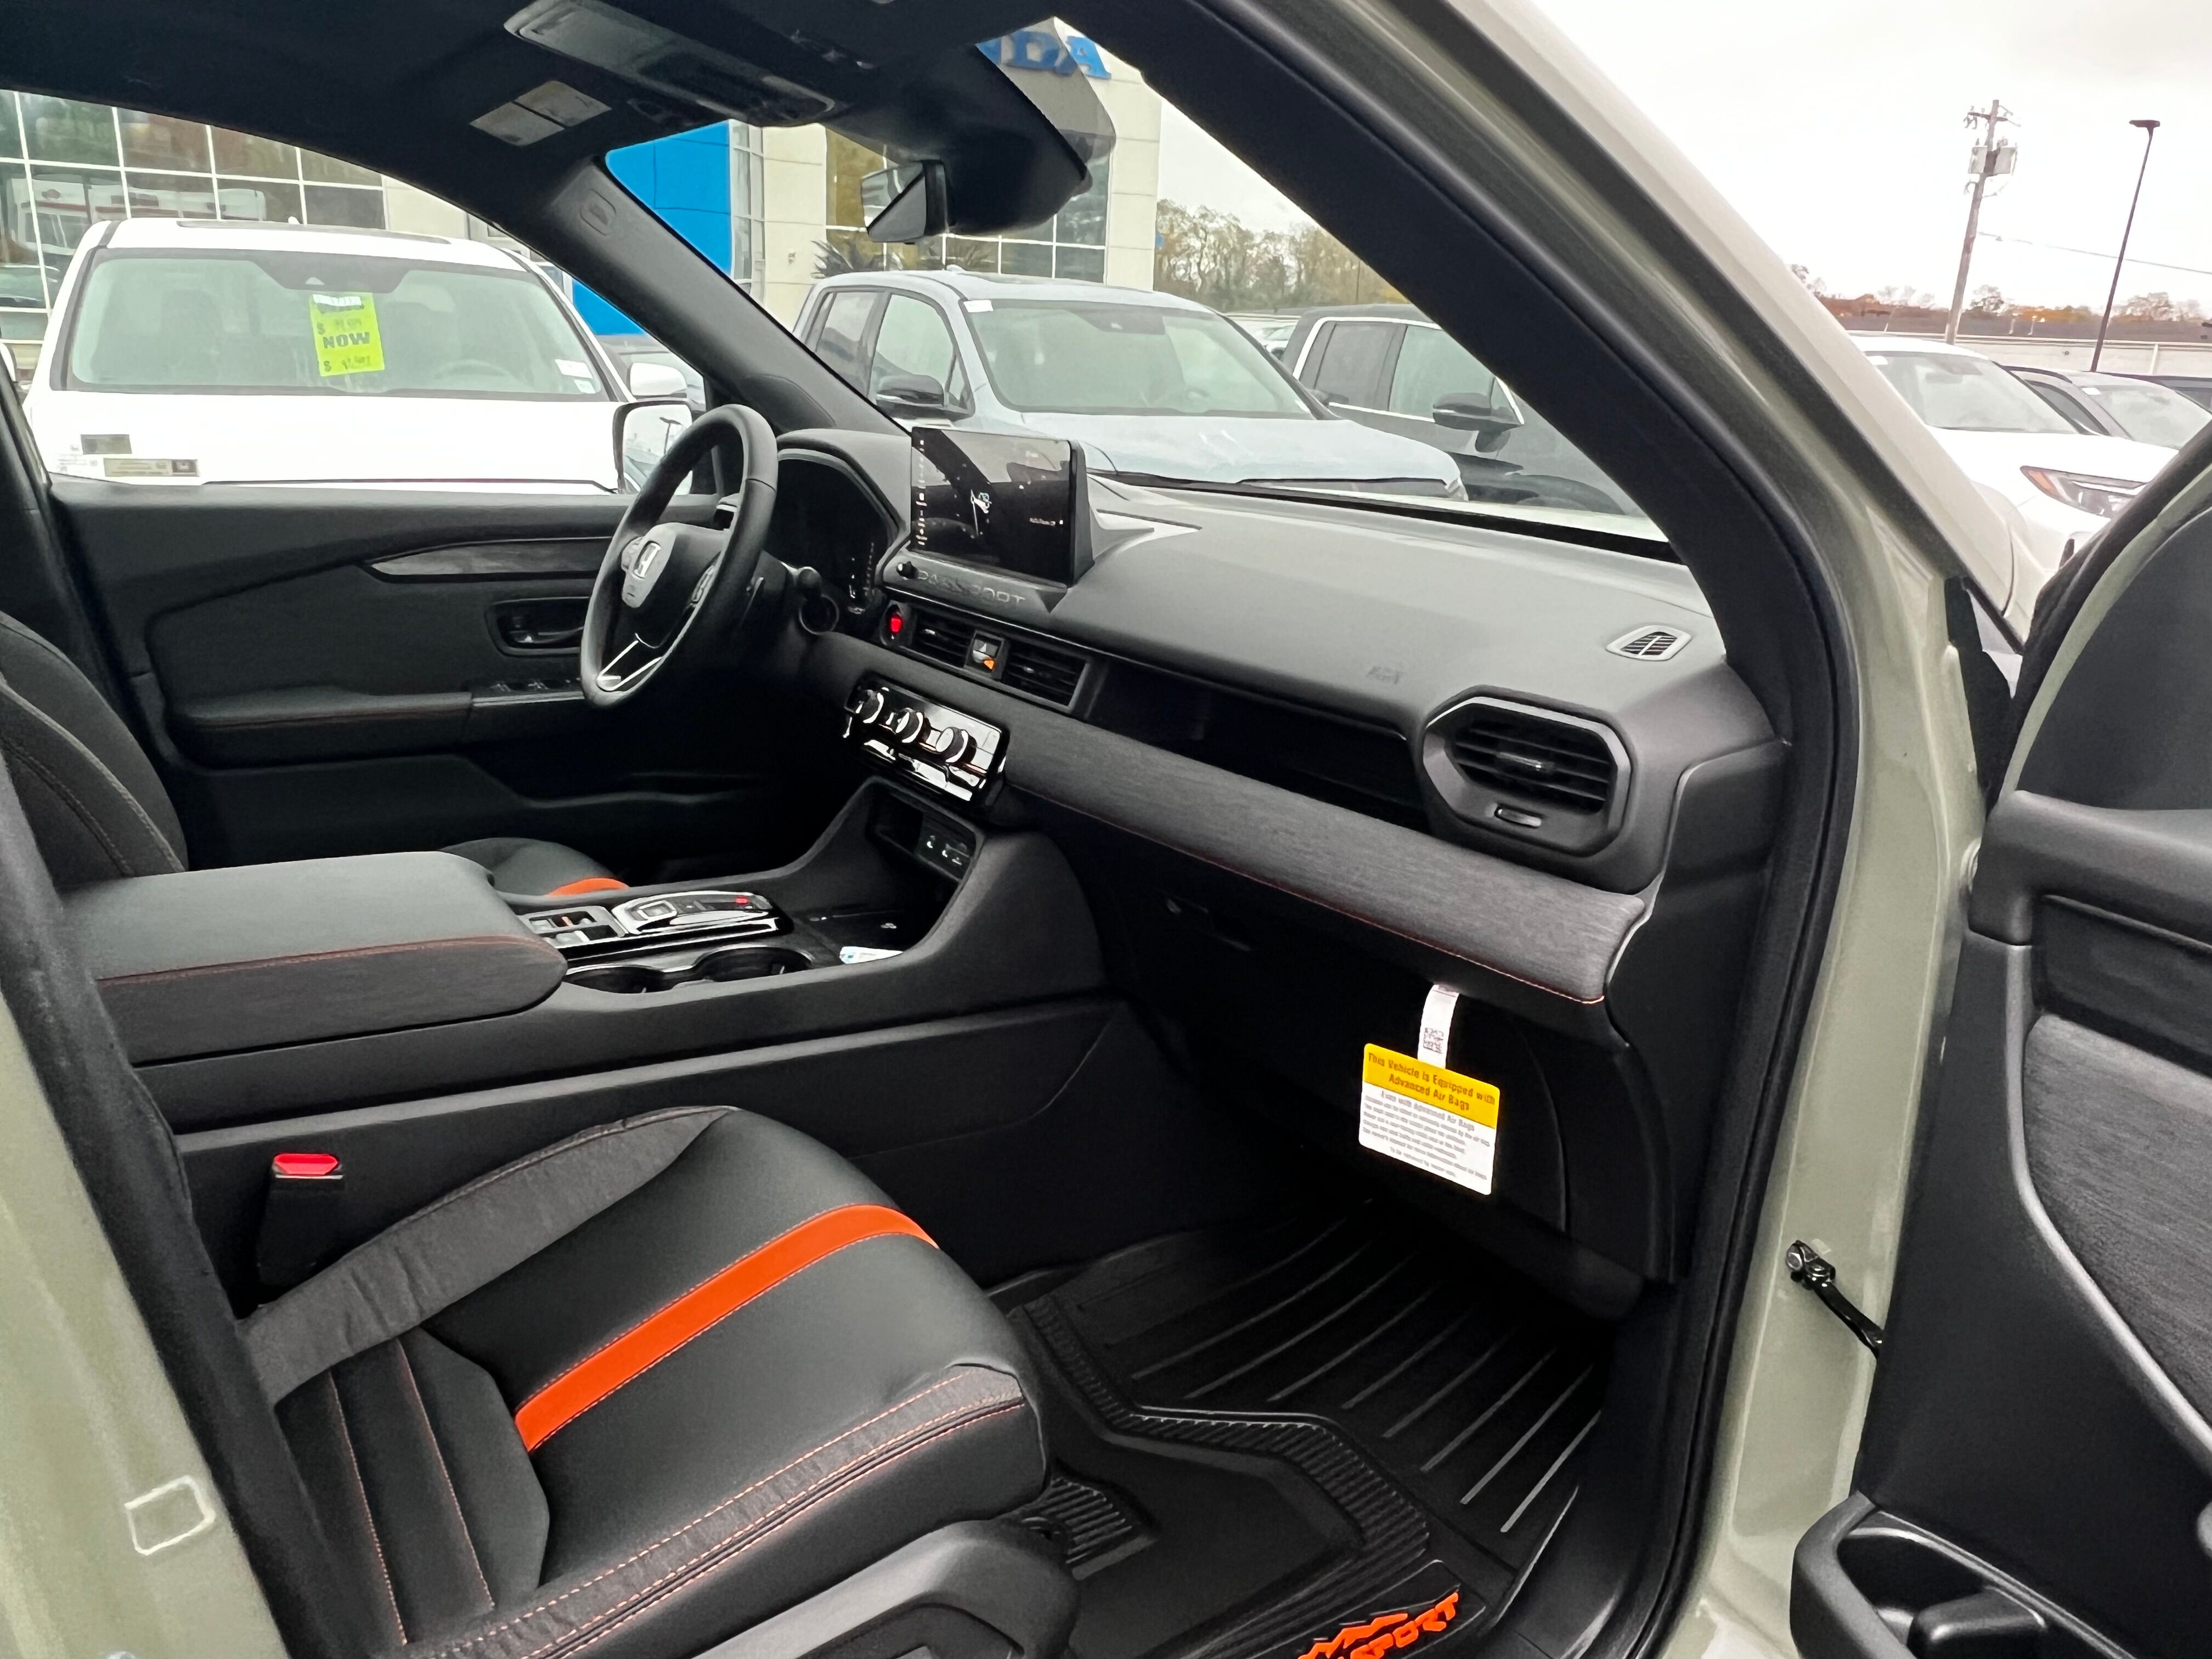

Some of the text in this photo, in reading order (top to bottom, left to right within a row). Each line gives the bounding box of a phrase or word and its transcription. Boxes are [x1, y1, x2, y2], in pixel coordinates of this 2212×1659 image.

[323, 332, 370, 349] NOW
[1368, 1052, 1495, 1105] This Vehicle is Equipped with
[1389, 1074, 1469, 1111] Advanced Air Bags
